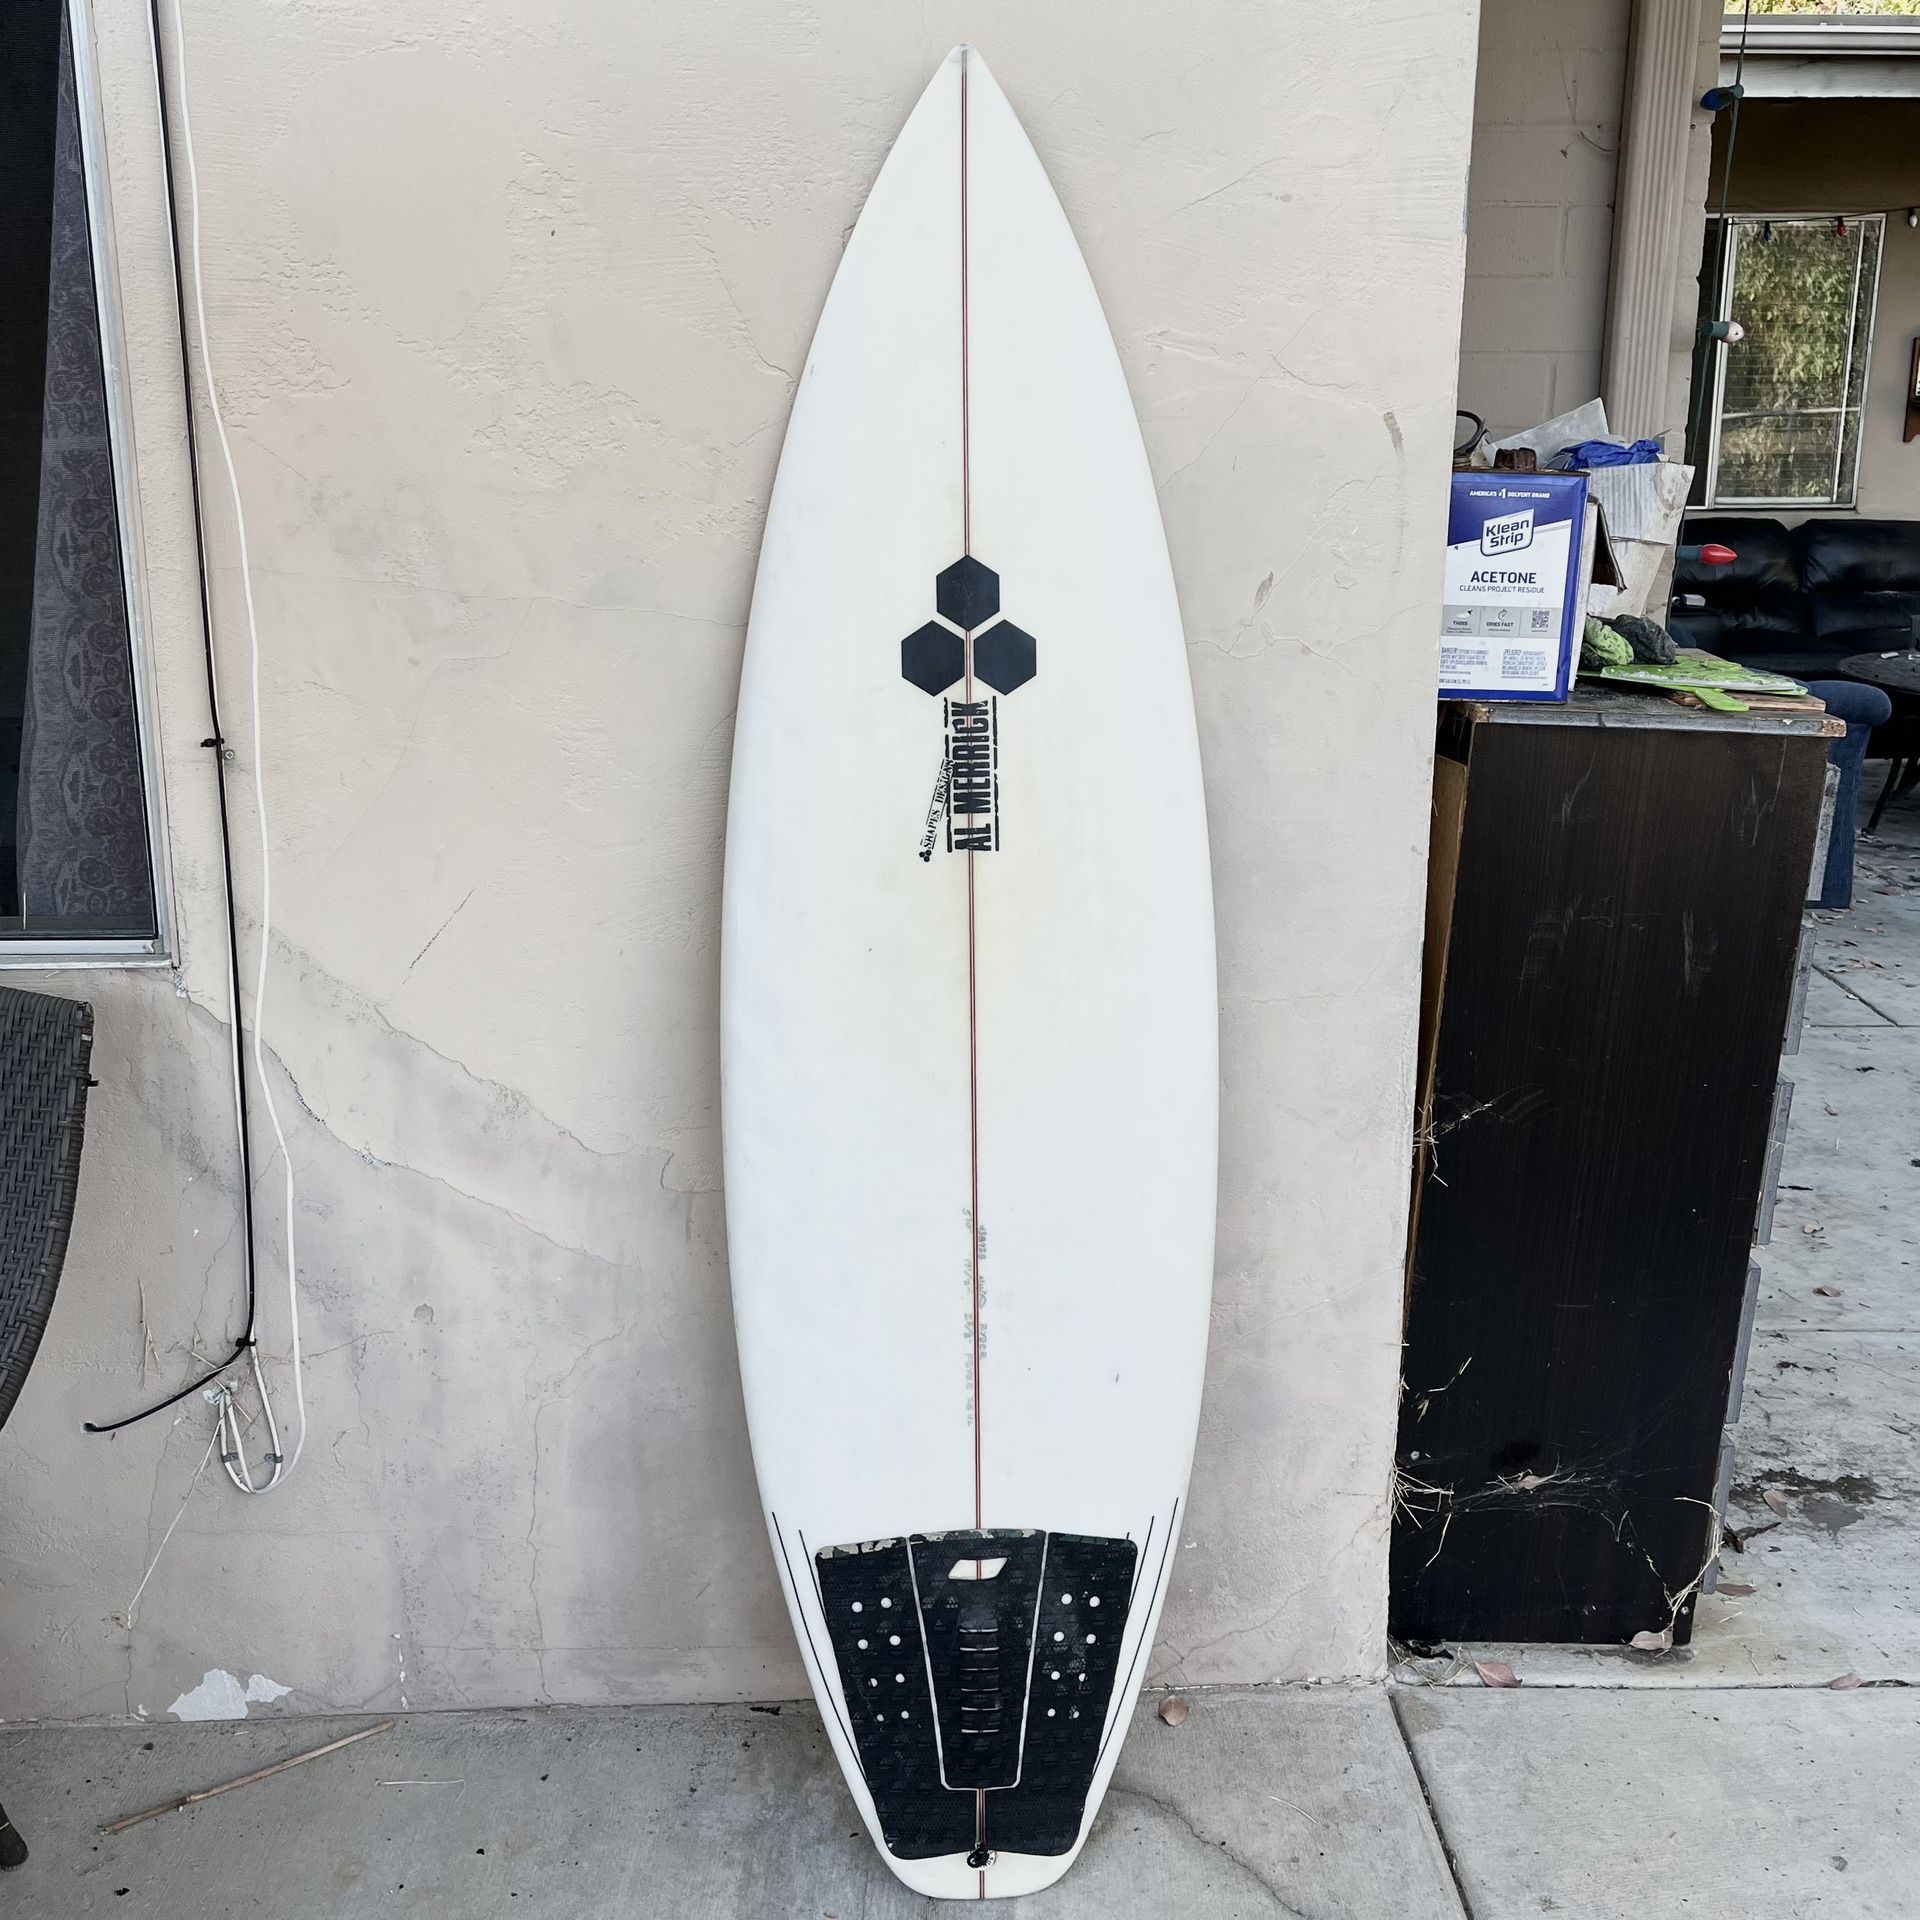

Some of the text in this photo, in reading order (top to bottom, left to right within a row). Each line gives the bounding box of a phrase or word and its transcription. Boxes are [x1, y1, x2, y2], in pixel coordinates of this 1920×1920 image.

[1486, 519, 1530, 537] Klean
[1489, 532, 1524, 548] Strip
[1470, 571, 1537, 584] ACETONE
[1459, 585, 1486, 593] CLEANS
[1517, 586, 1545, 594] RESIDUE
[951, 699, 992, 852] AL MERRICK
[921, 757, 954, 849] SHAPES DESIGNS
